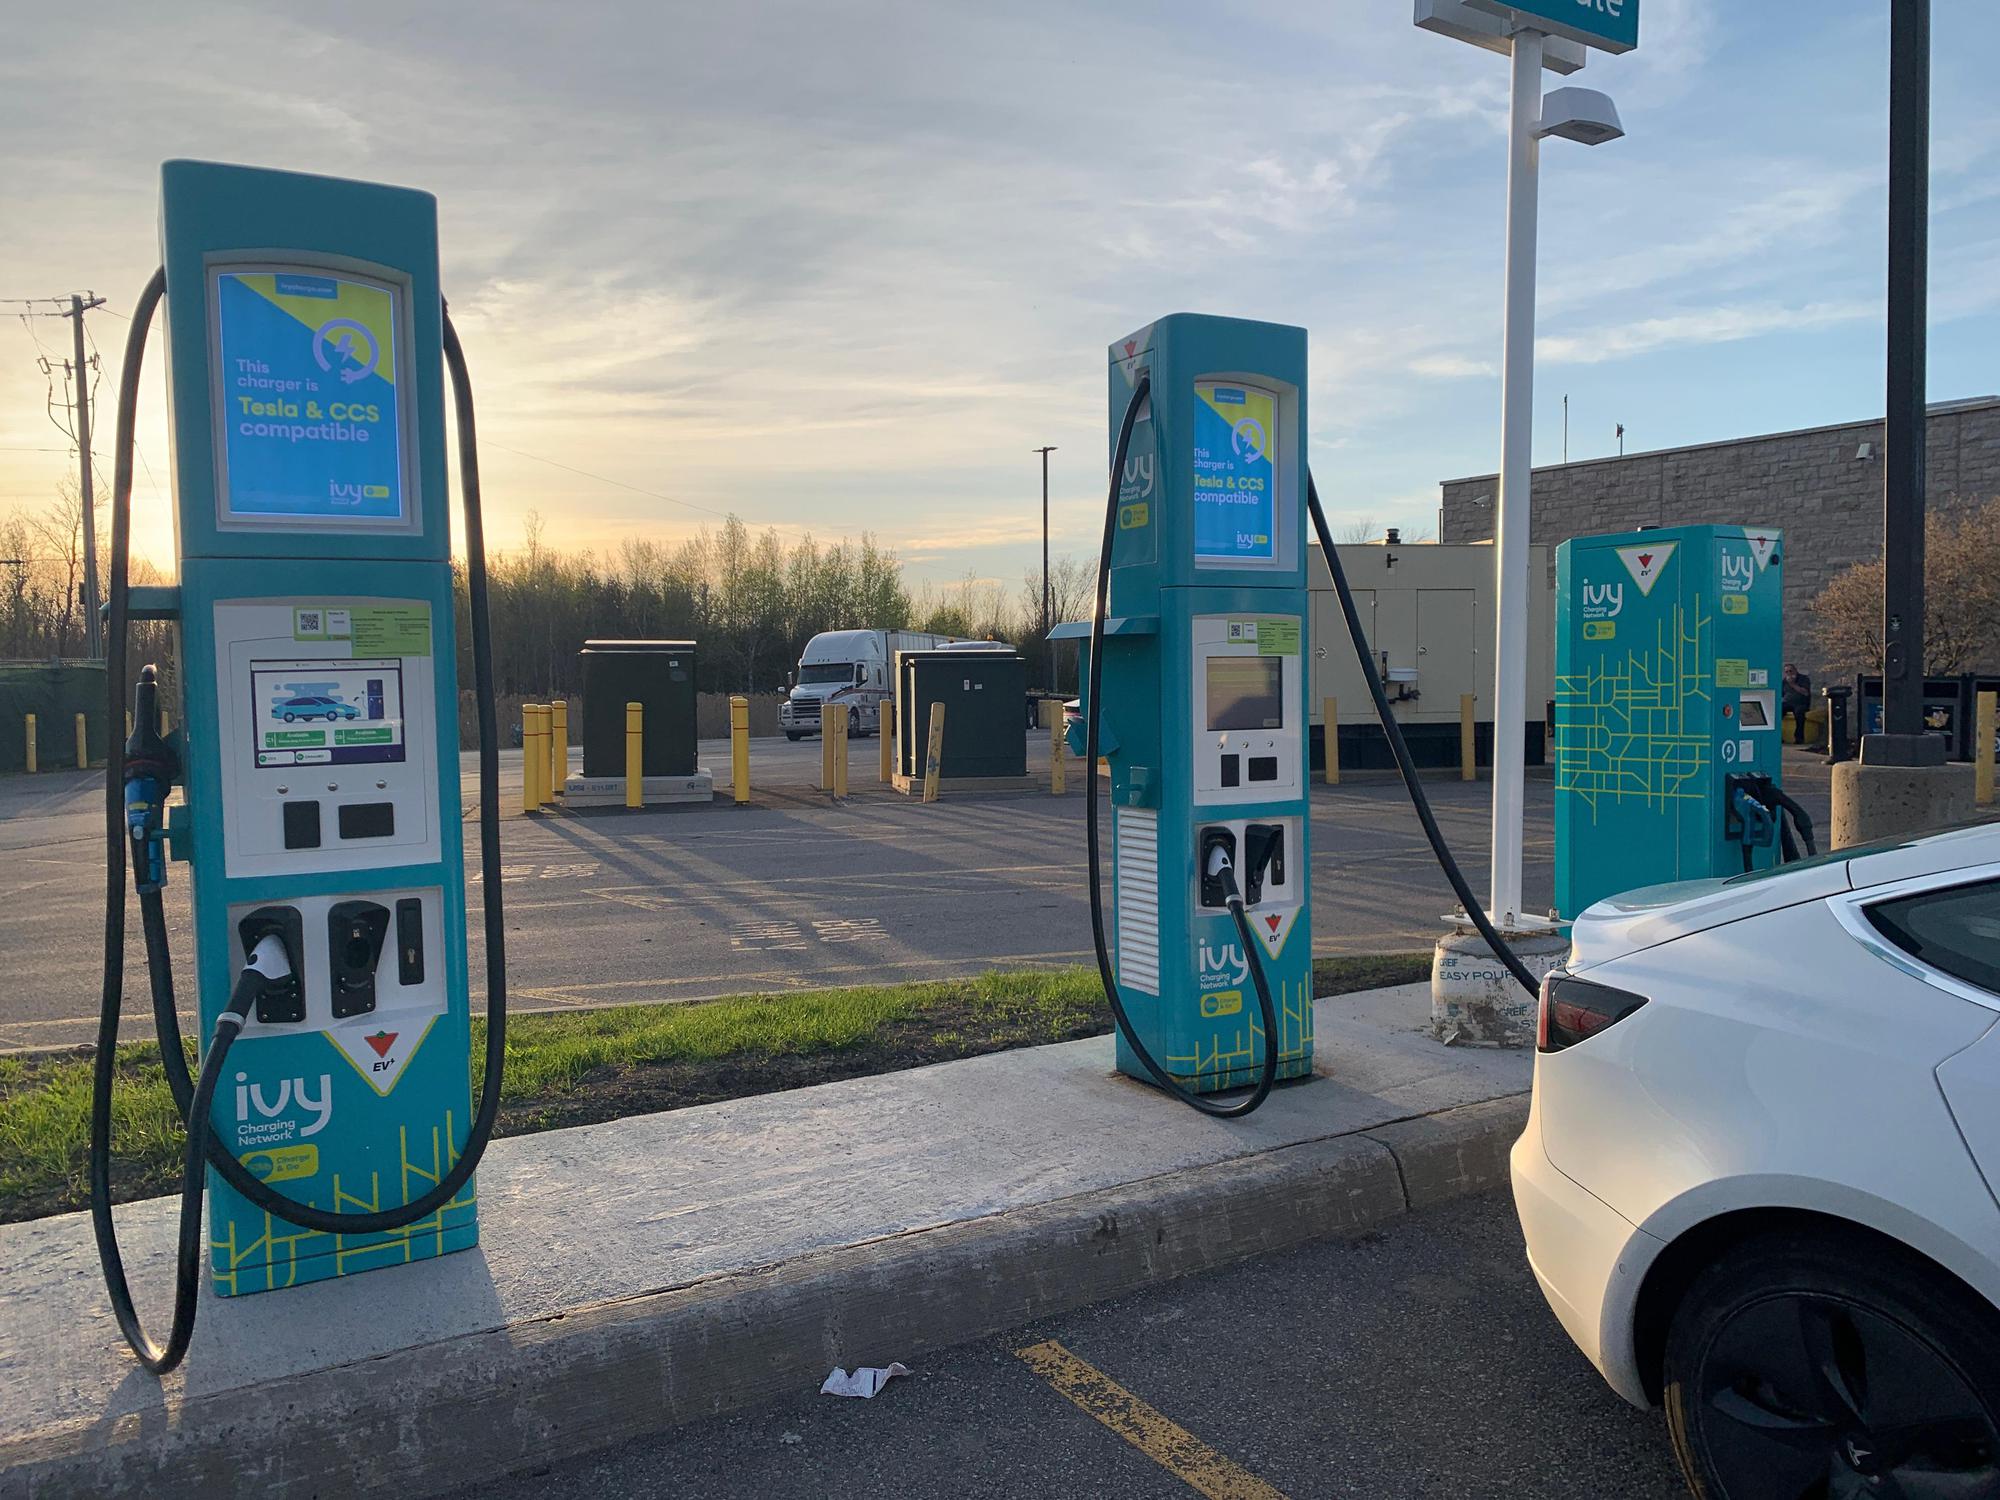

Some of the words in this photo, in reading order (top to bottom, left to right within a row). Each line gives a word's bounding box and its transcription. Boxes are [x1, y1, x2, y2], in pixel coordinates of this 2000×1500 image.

[236, 358, 270, 374] This
[237, 374, 301, 393] charger
[306, 377, 318, 391] is
[238, 396, 298, 417] Tesla
[306, 400, 323, 419] &
[329, 402, 380, 422] CCS
[239, 421, 369, 443] compatible
[1194, 447, 1210, 458] This
[1227, 459, 1234, 470] is
[1121, 453, 1153, 498] vy
[1194, 474, 1223, 488] Tesla
[1227, 476, 1235, 489] &
[1238, 476, 1265, 491] CCS
[329, 478, 362, 505] ivy
[1194, 491, 1259, 506] compatible
[1236, 530, 1254, 549] ivy
[1721, 547, 1754, 591] ivy
[1583, 578, 1623, 617] ivy
[1199, 937, 1249, 986] ivy
[1550, 956, 1567, 970] EAS
[1440, 970, 1470, 981] EASY
[235, 1072, 332, 1137] ivy
[238, 1119, 296, 1135] Charging
[238, 1129, 293, 1147] Network
